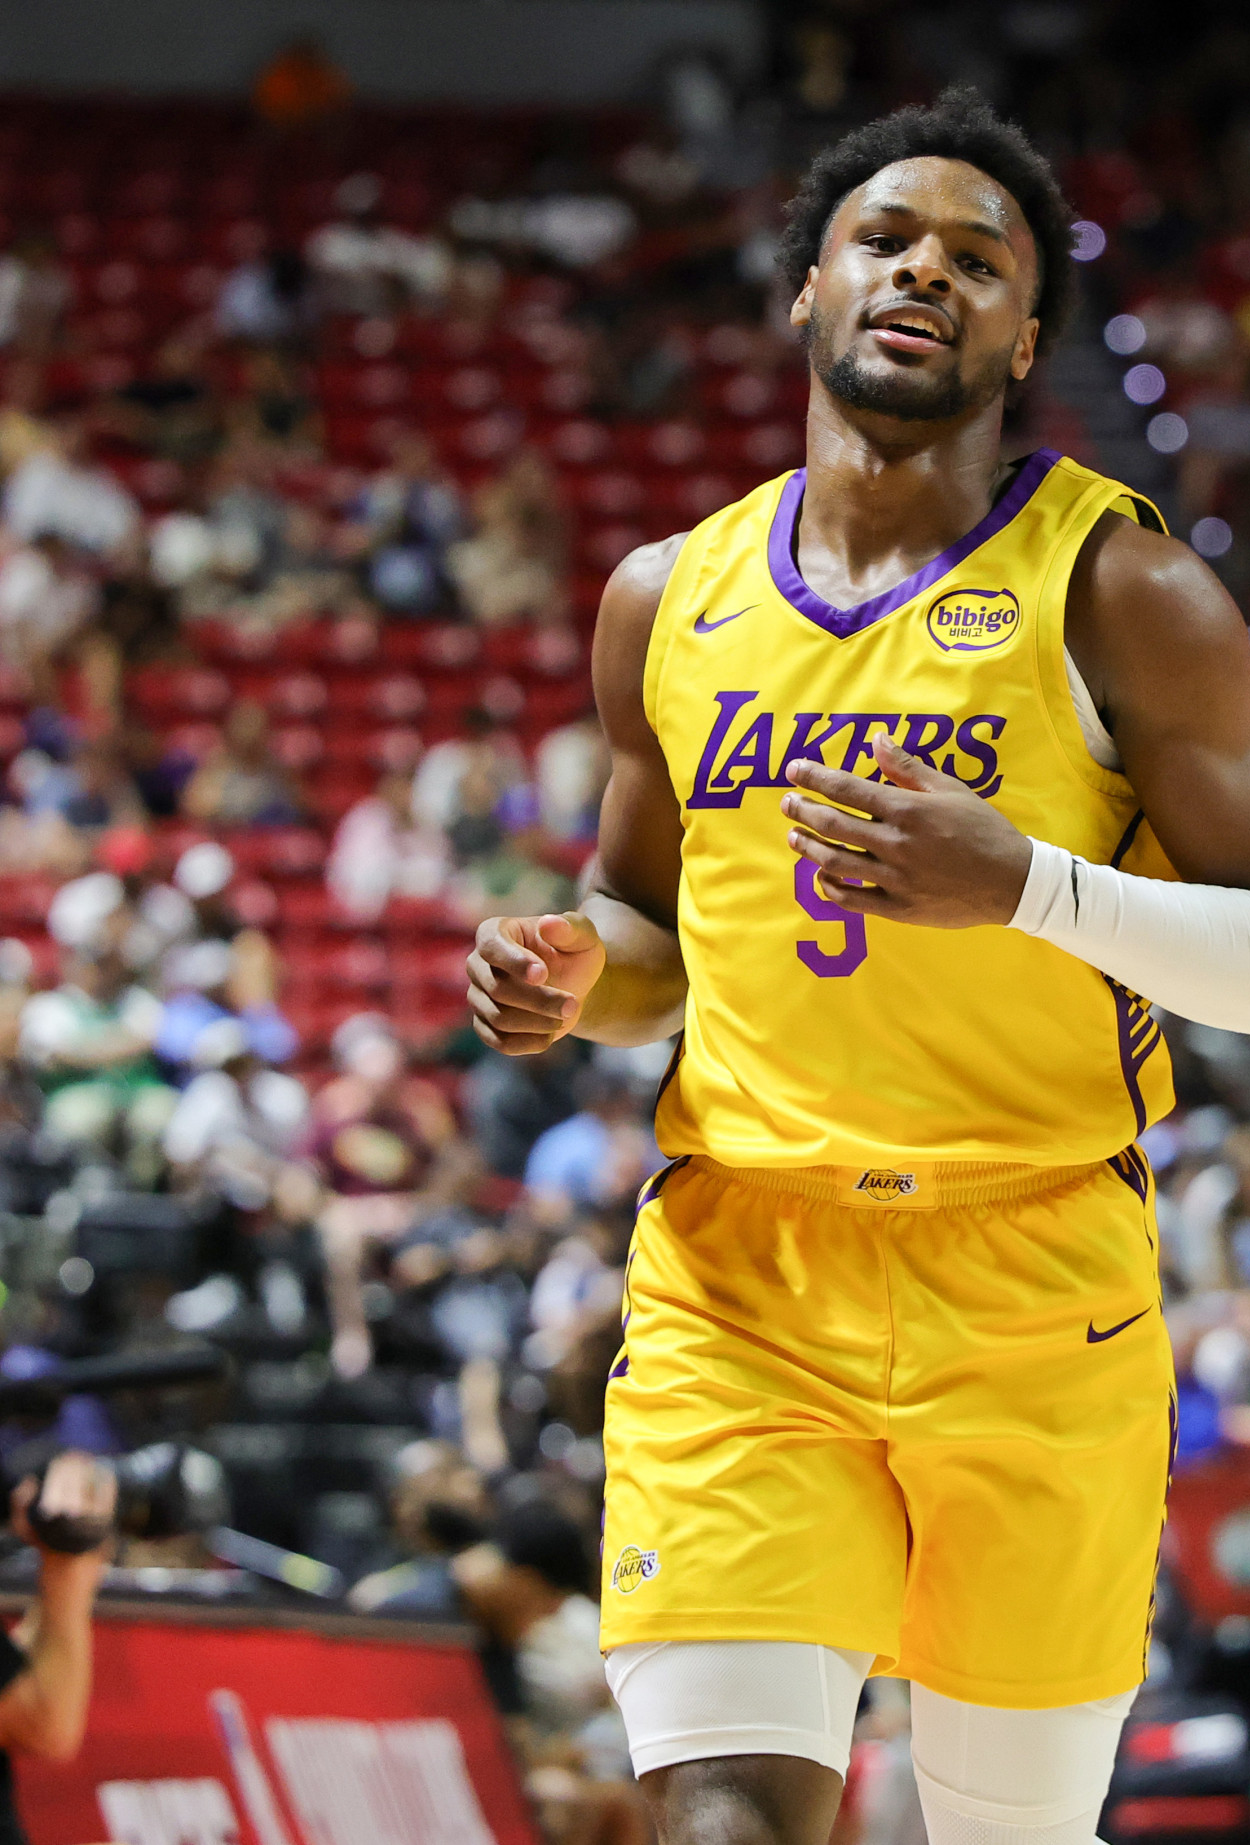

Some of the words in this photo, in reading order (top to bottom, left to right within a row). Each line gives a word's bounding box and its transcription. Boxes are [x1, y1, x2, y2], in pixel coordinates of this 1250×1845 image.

[937, 605, 1016, 632] bibigo
[949, 627, 982, 638] 비비고
[686, 691, 1008, 809] LAKERS
[854, 1172, 917, 1193] LAKERS
[612, 1558, 657, 1585] LAKERS
